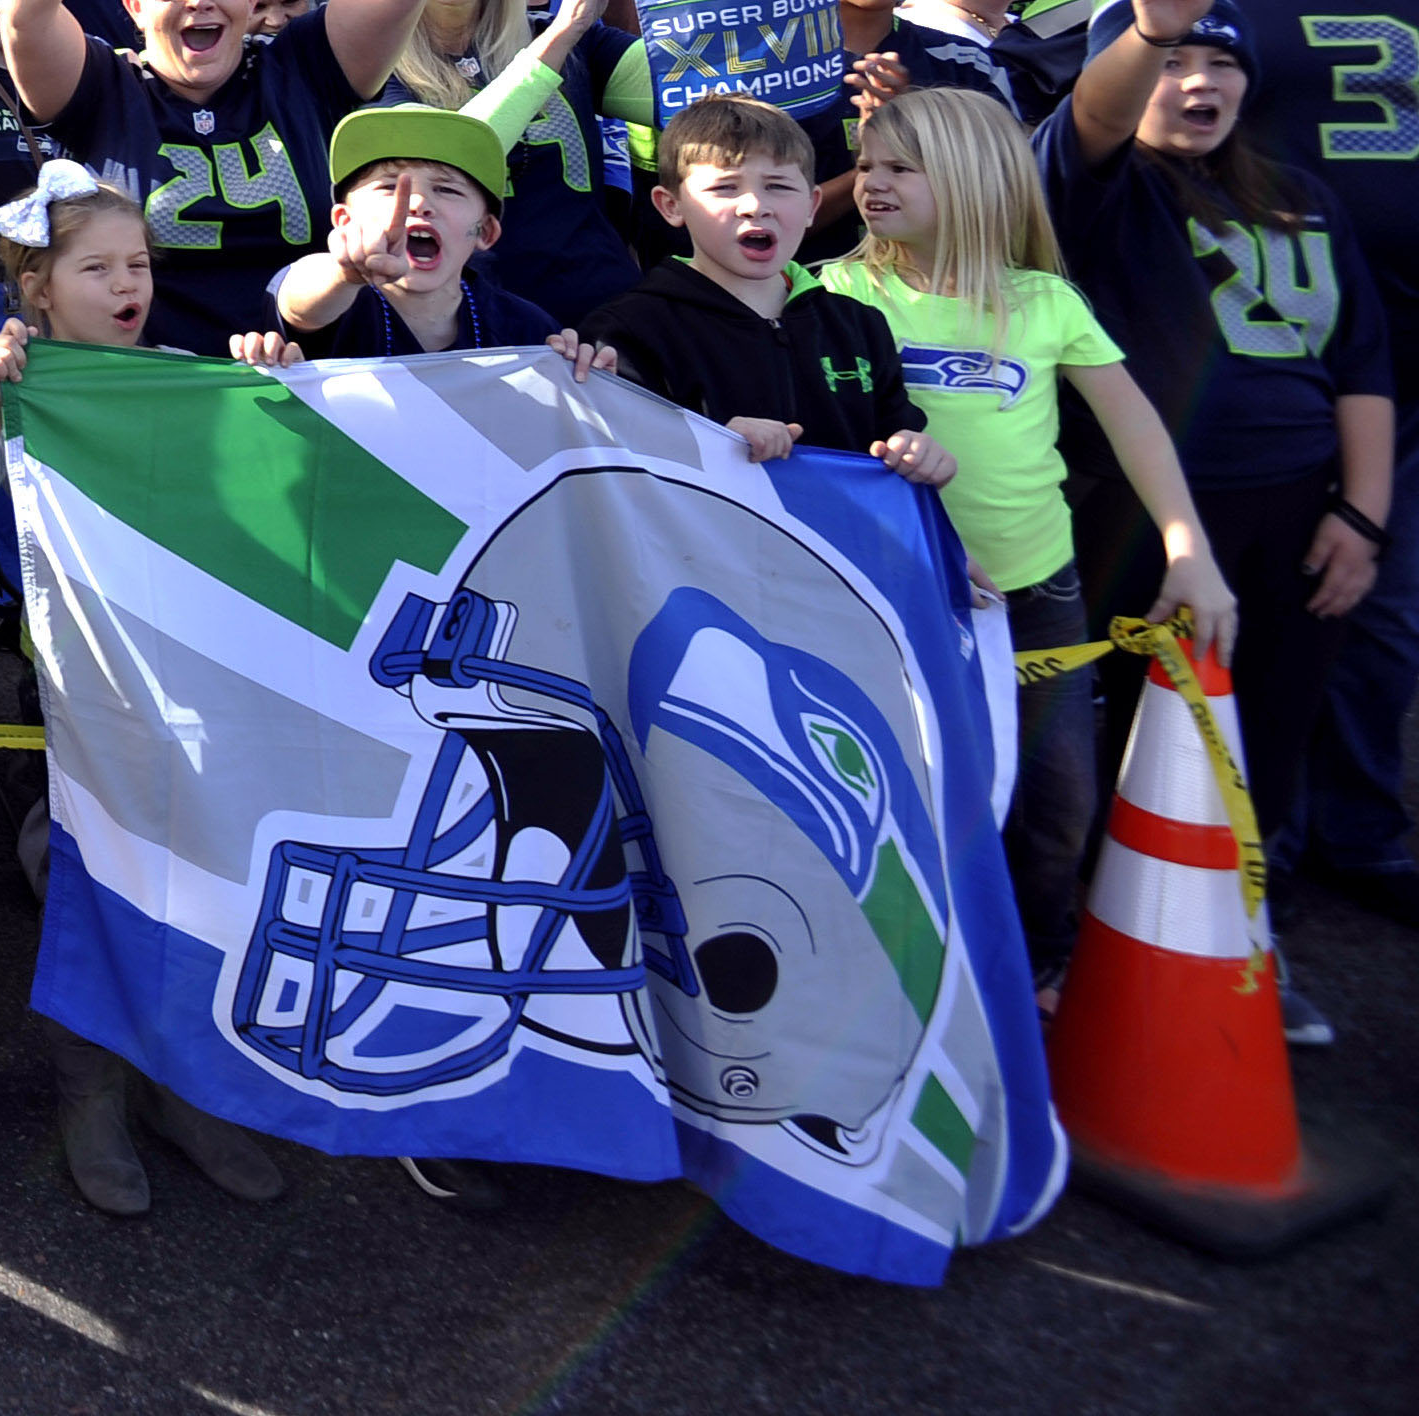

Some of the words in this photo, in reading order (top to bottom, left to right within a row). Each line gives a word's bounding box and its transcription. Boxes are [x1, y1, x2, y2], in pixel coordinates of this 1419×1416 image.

[651, 4, 763, 38] SUPER
[662, 53, 844, 108] CHAMPIONS
[1299, 14, 1419, 160] 3
[144, 121, 312, 250] 24
[1185, 215, 1342, 359] 24
